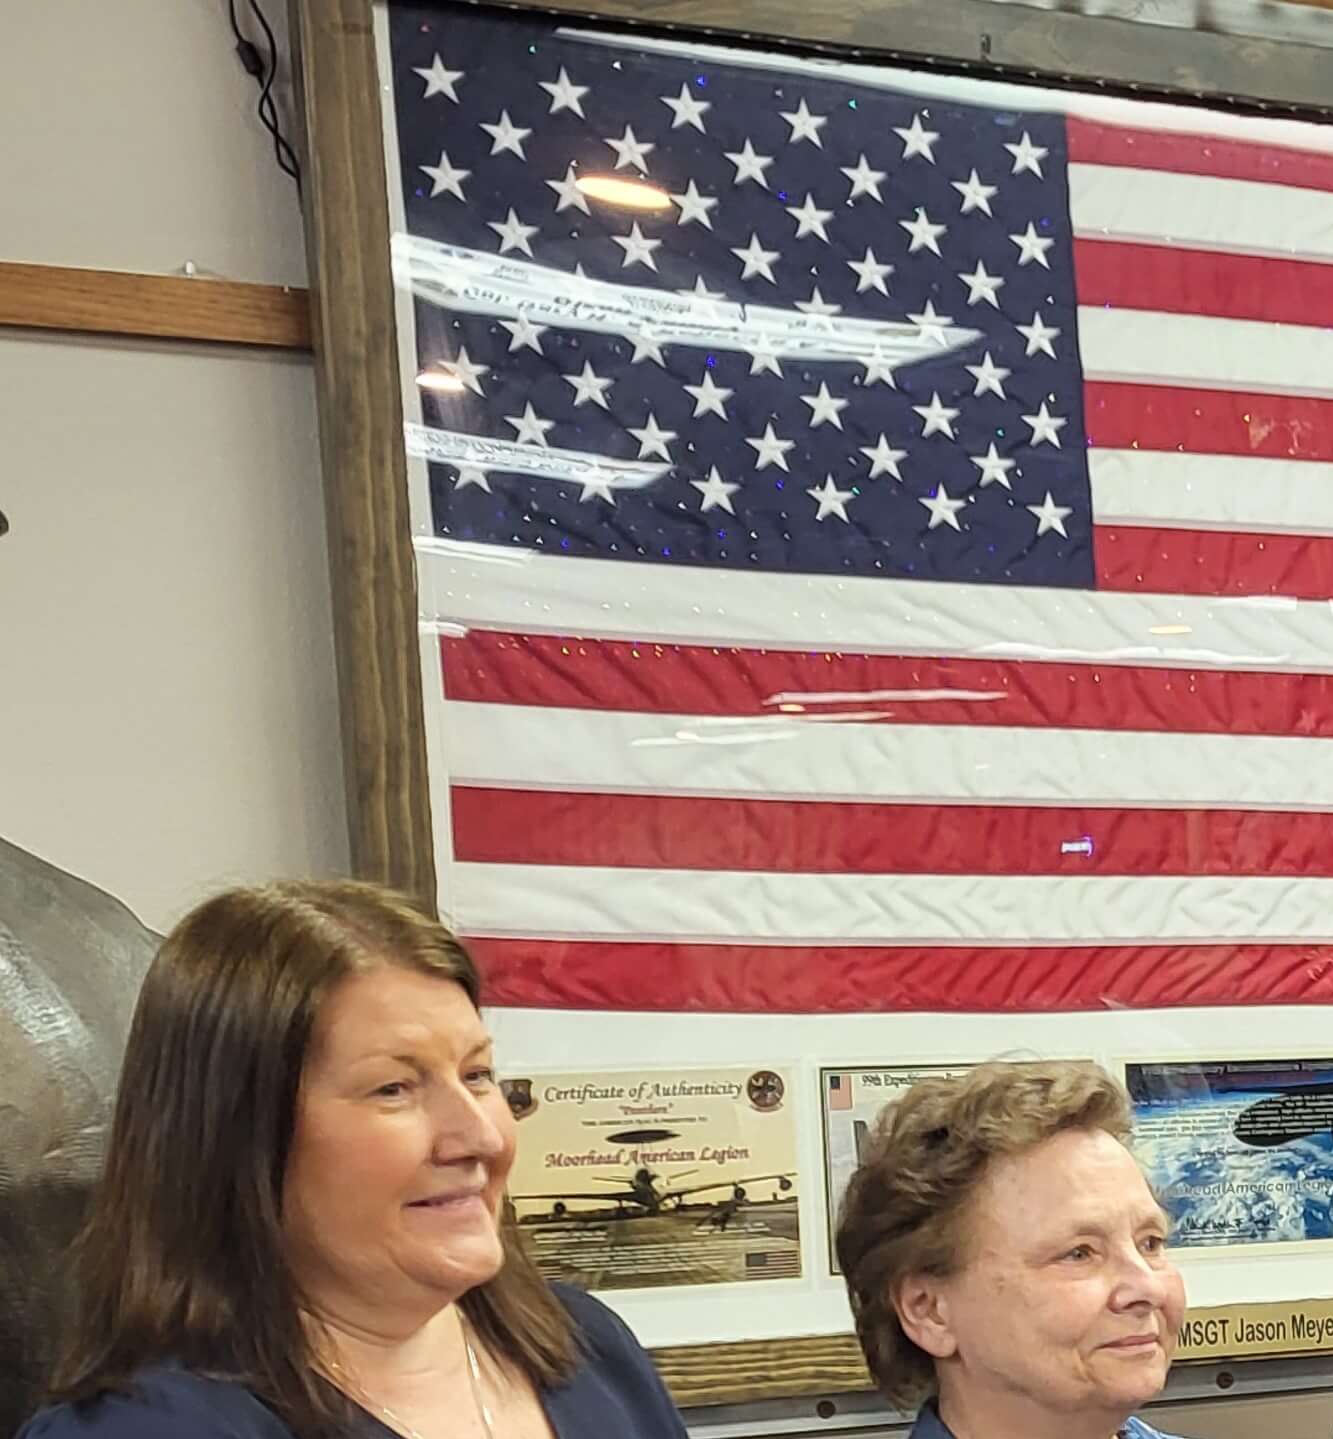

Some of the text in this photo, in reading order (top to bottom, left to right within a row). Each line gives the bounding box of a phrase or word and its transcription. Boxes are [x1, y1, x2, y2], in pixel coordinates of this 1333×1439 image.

[544, 1080, 743, 1104] Certificate of Authenticity
[624, 1148, 696, 1167] American
[699, 1146, 750, 1165] Legion
[1226, 1180, 1293, 1195] American
[1178, 1319, 1229, 1348] MSGT
[1235, 1318, 1287, 1344] Jason
